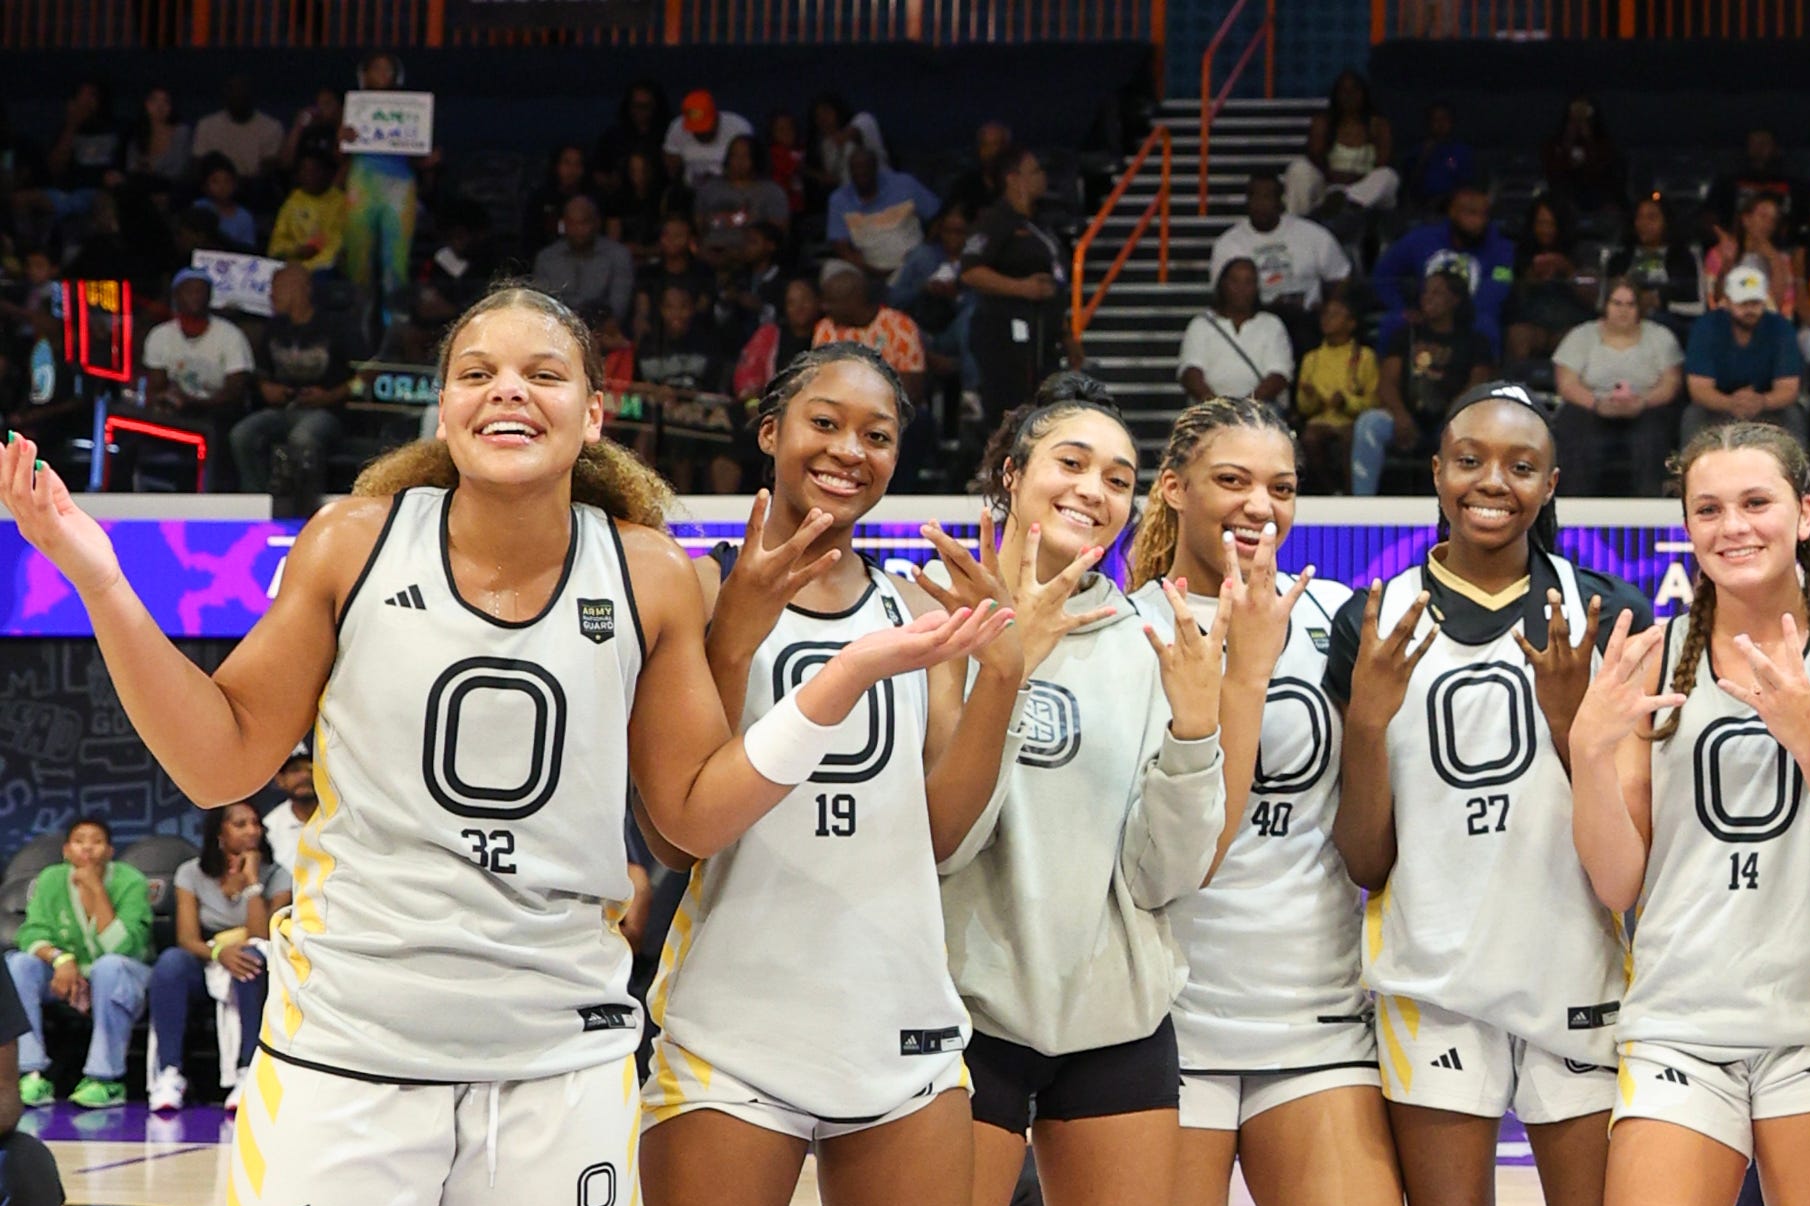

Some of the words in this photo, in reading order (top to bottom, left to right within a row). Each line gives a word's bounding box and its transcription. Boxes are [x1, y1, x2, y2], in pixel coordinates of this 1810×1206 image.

[582, 606, 613, 617] ARMY
[582, 620, 614, 630] GUARD
[815, 793, 856, 837] 19
[1251, 801, 1293, 837] 40
[1466, 793, 1510, 836] 27
[461, 829, 517, 874] 32
[1728, 852, 1759, 891] 14
